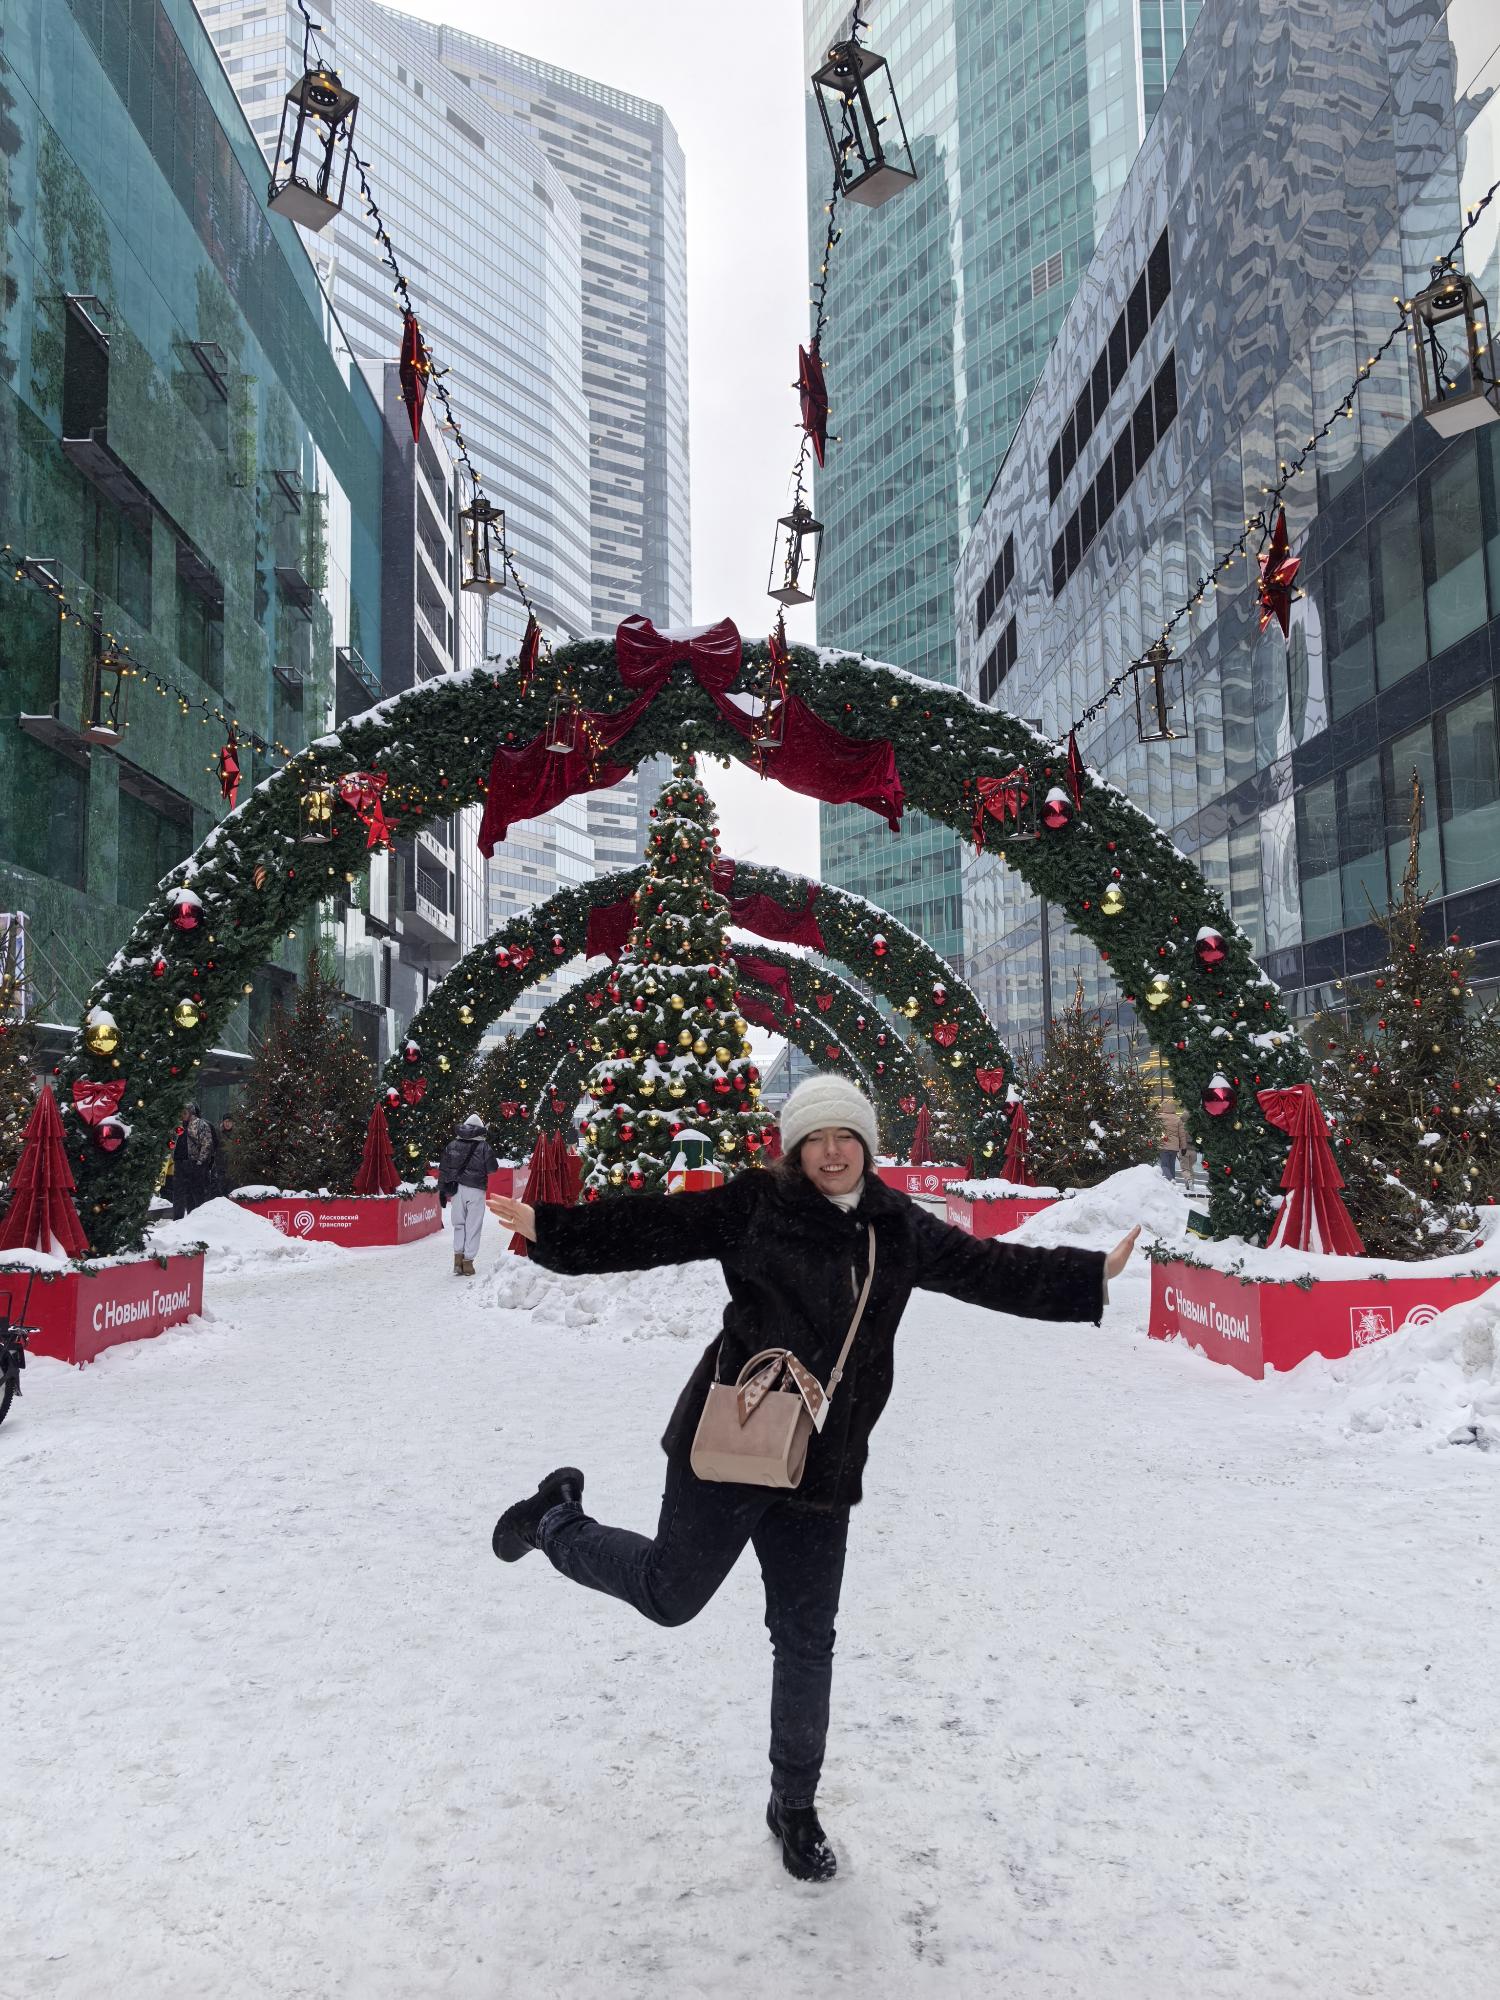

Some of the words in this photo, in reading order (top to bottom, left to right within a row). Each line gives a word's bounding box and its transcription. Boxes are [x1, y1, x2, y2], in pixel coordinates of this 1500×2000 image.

[92, 1303, 103, 1332] С
[104, 1299, 150, 1329] Новым
[151, 1282, 191, 1318] Годом!
[1164, 1286, 1175, 1312] С
[1175, 1288, 1208, 1327] Новым
[1209, 1301, 1250, 1344] Годом!
